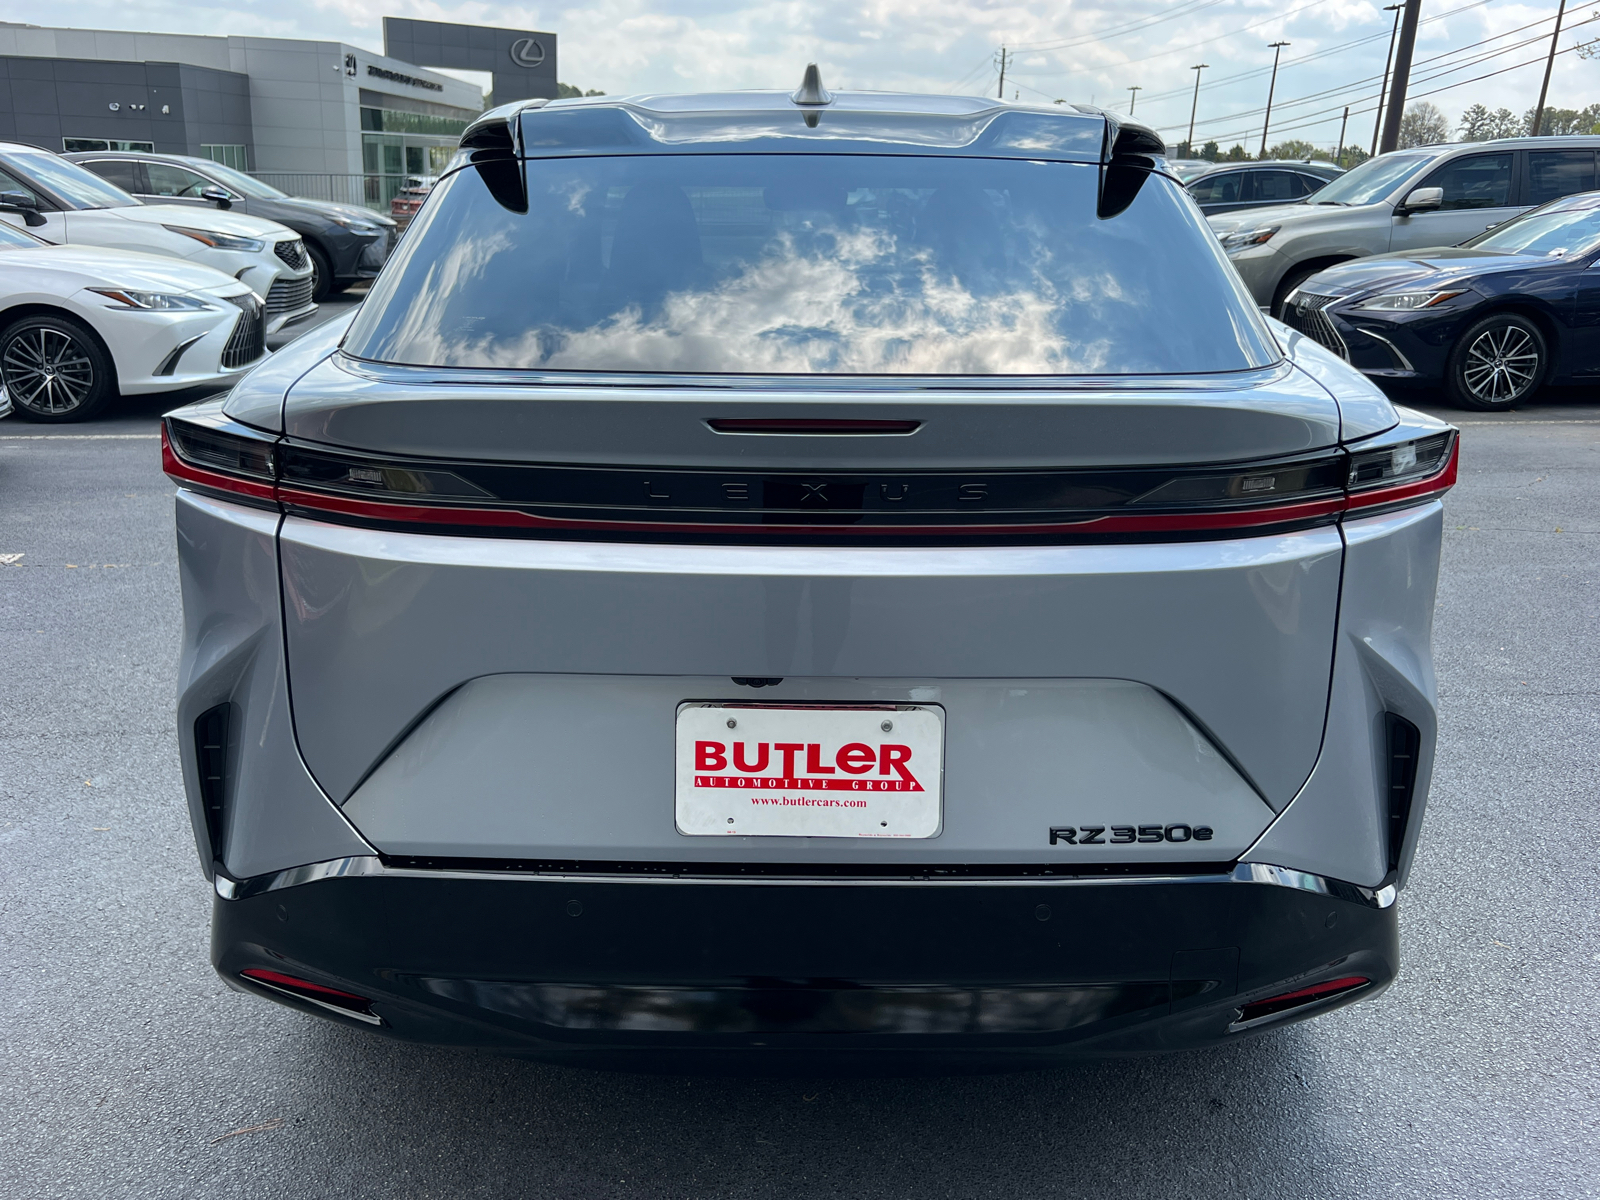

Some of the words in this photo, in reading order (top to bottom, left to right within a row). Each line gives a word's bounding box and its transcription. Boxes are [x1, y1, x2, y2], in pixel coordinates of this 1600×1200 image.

[643, 481, 988, 501] LEXUS
[695, 776, 828, 789] AUTOMOTIVE
[852, 781, 916, 790] GROUP
[751, 796, 867, 808] www.butlercars.com
